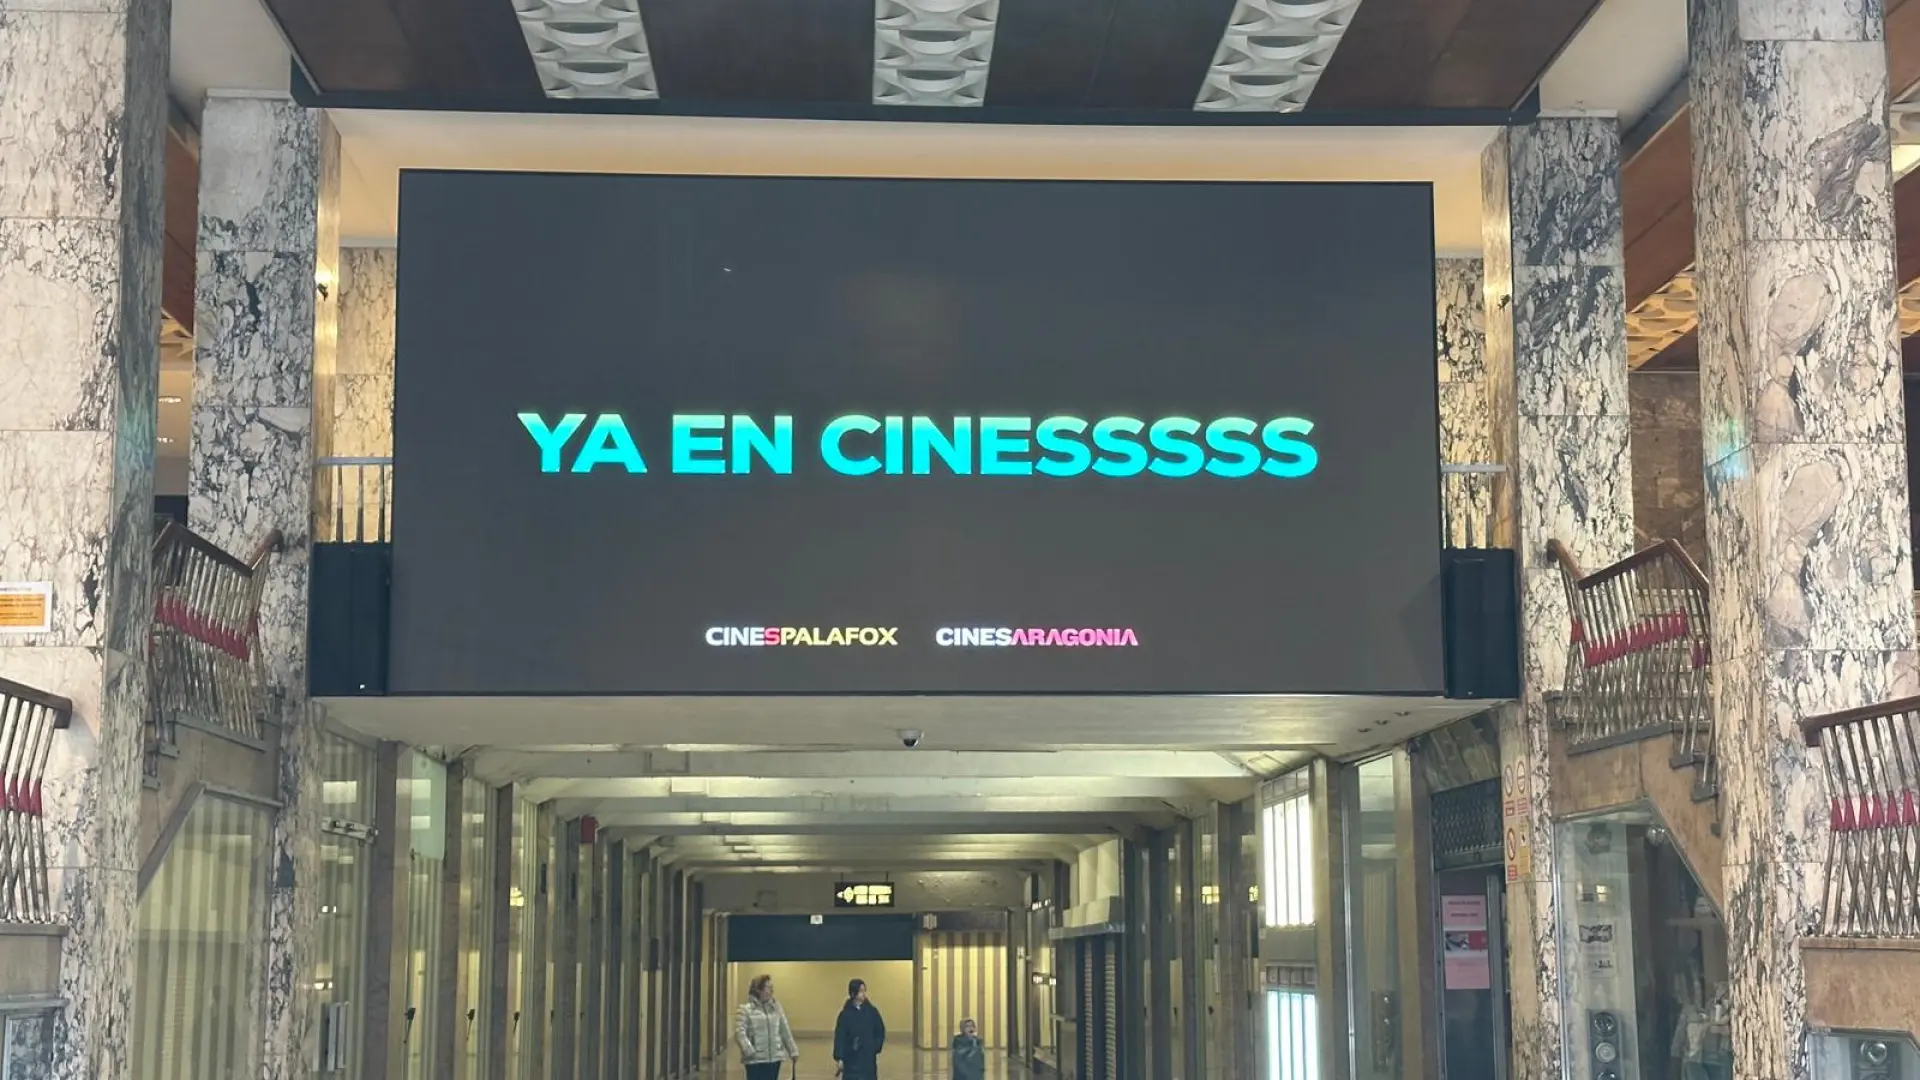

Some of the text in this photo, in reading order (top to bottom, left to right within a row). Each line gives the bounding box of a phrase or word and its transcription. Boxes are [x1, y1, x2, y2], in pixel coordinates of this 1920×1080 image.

[517, 412, 1319, 479] YA EN CINESSSSS
